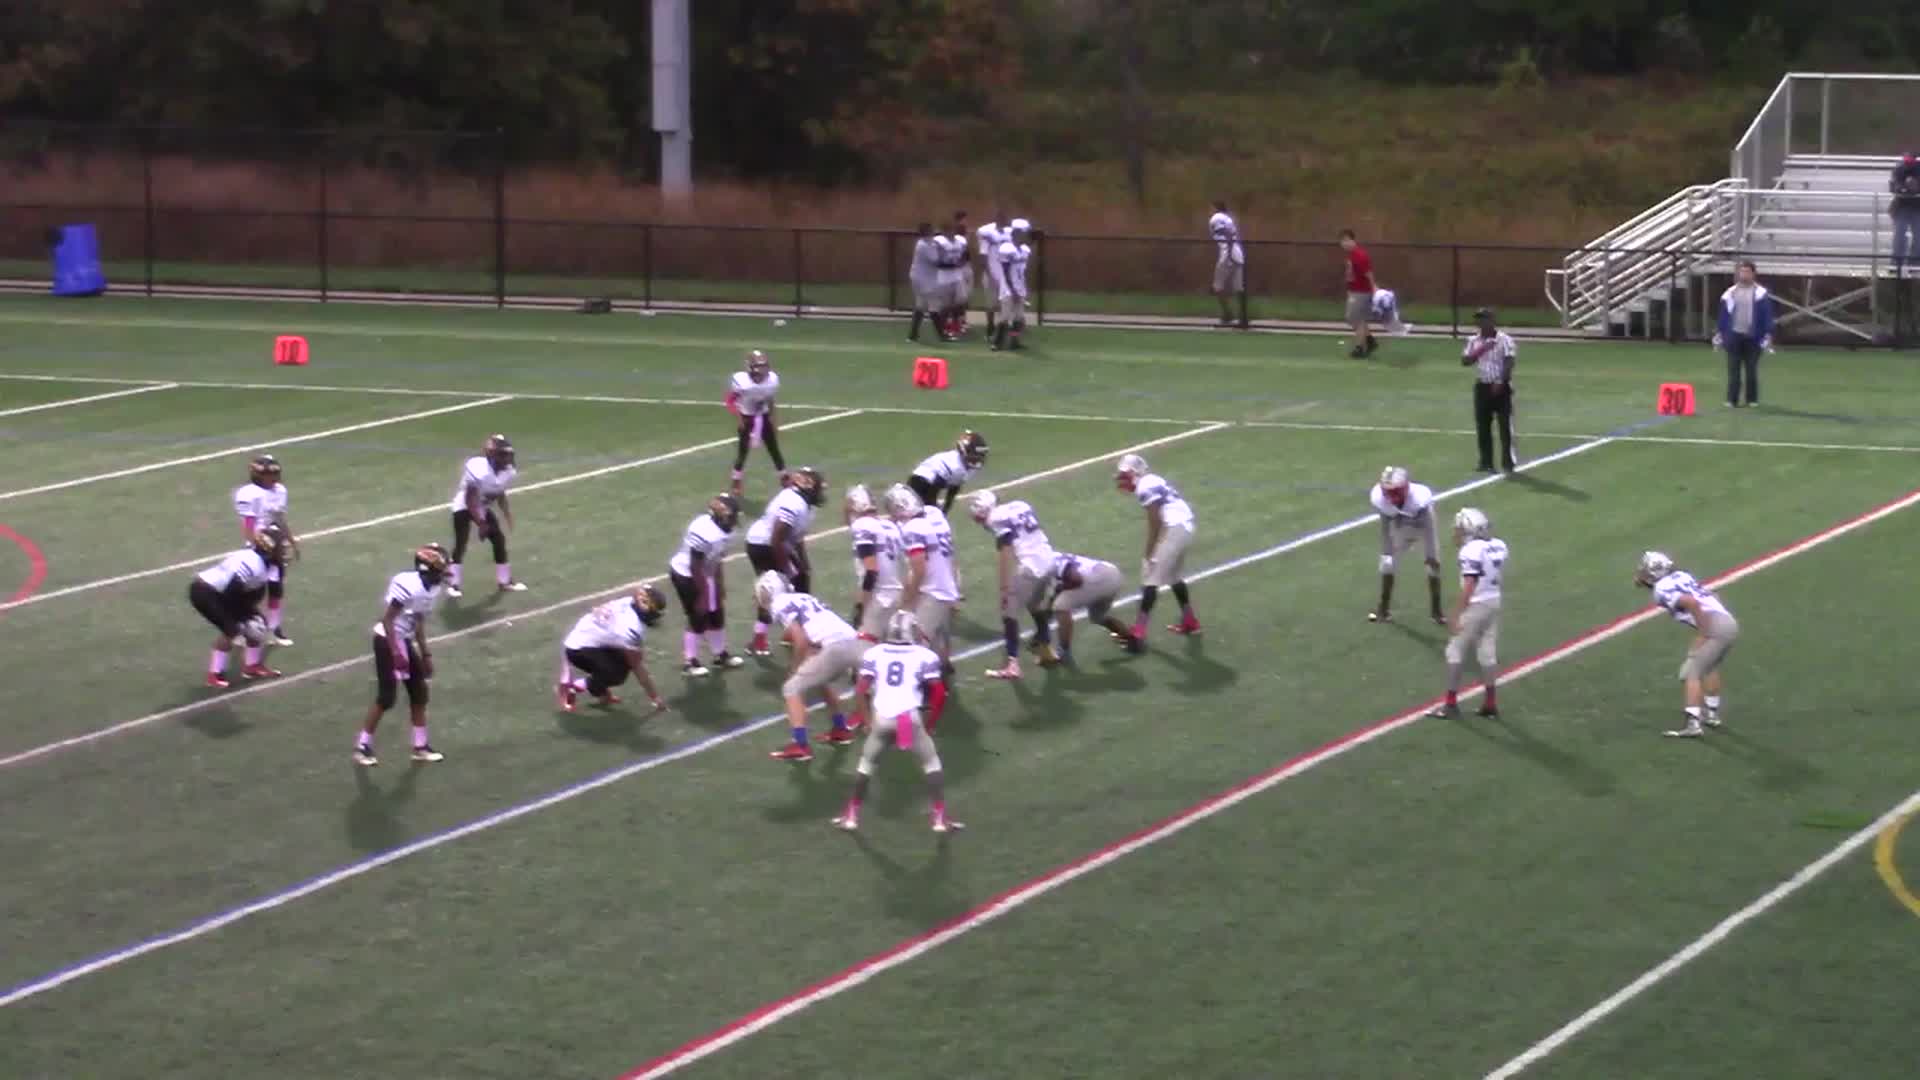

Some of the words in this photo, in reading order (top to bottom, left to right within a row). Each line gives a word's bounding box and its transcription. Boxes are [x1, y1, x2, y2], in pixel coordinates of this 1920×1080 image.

[279, 340, 299, 364] 10
[917, 361, 938, 387] 20
[1662, 387, 1686, 415] 30
[886, 660, 905, 688] 8
